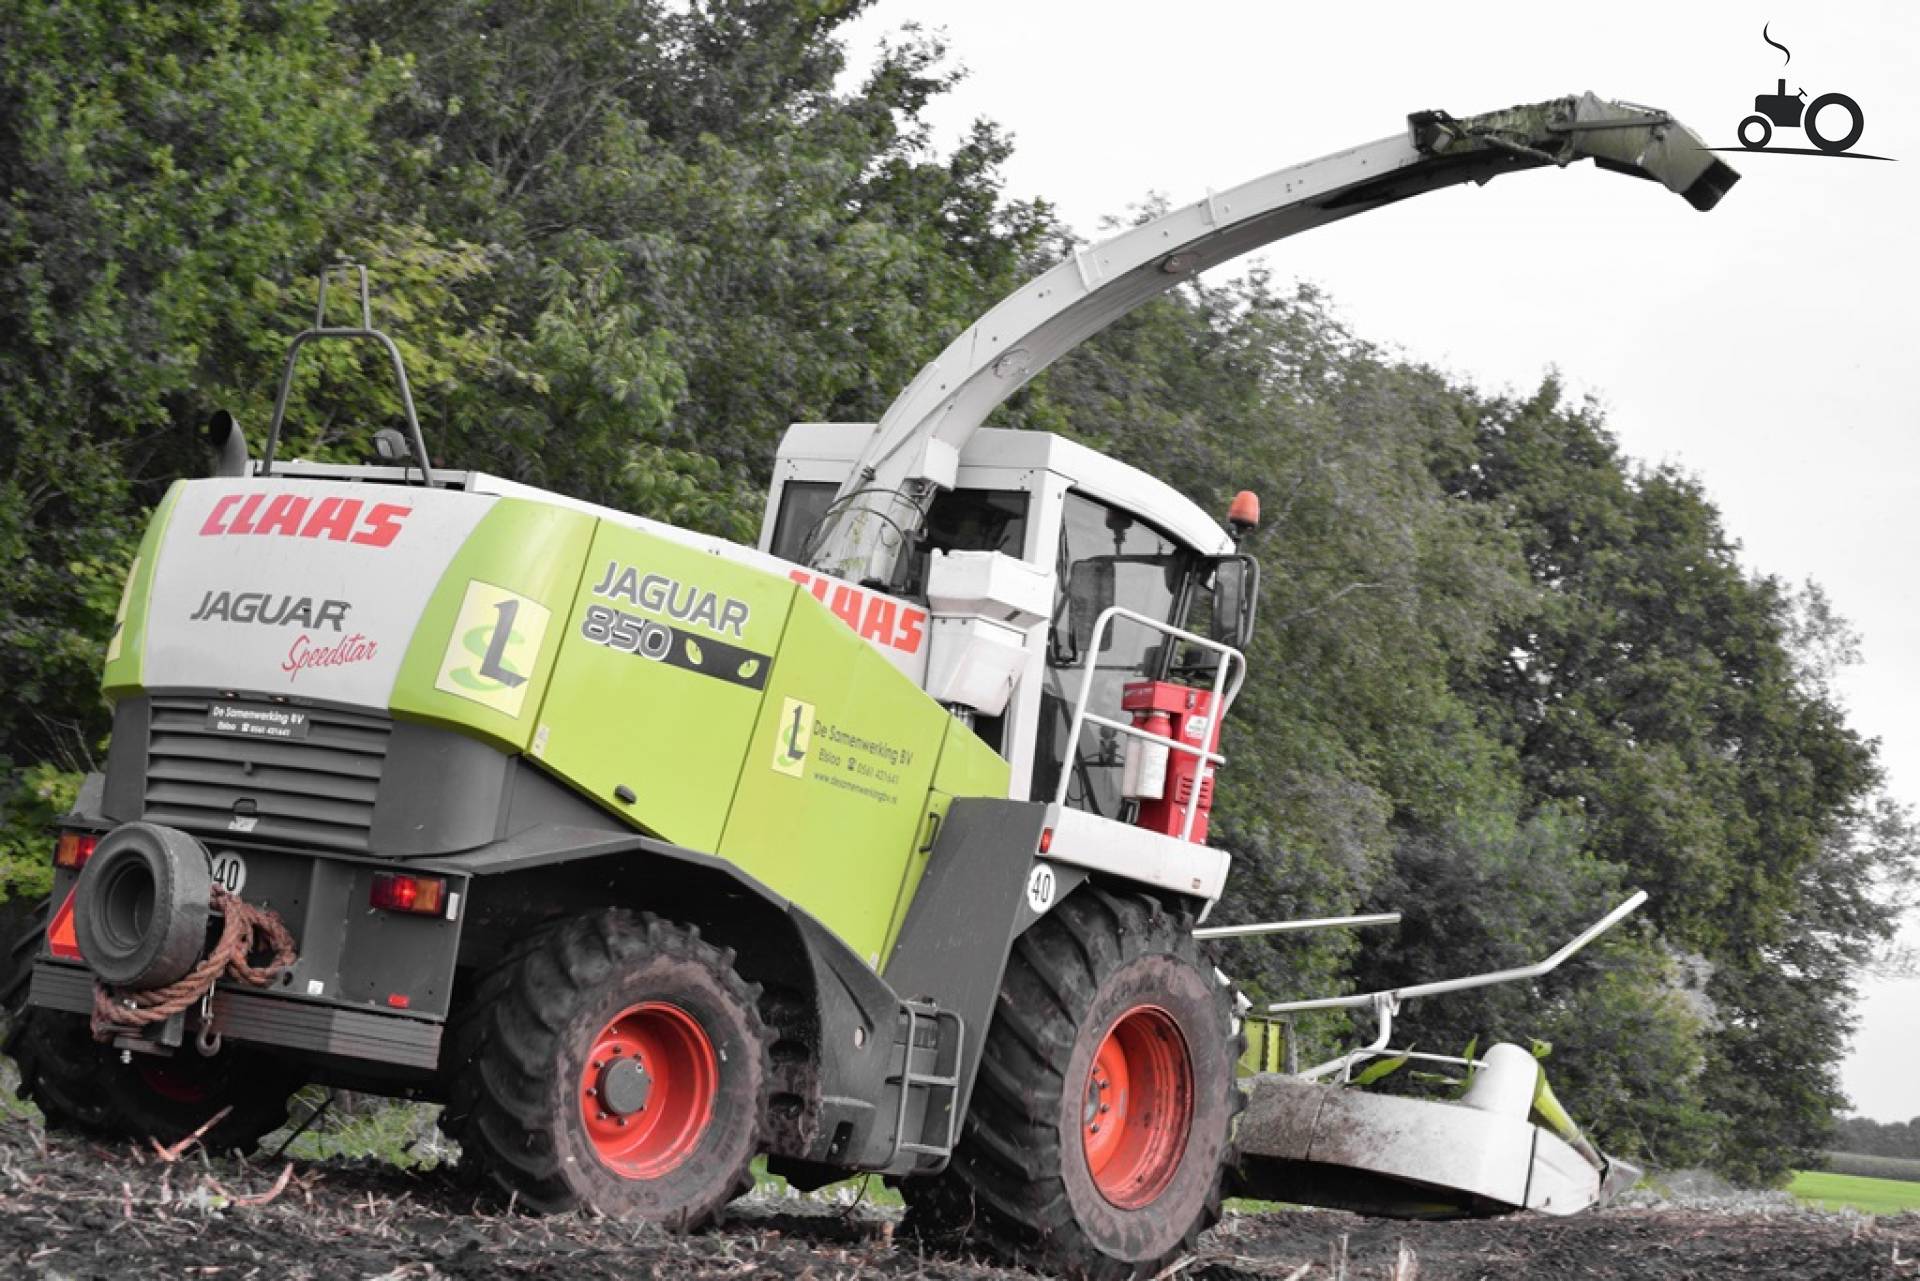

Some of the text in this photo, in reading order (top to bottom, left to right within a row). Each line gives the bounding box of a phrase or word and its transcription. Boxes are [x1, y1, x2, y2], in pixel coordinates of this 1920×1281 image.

[199, 494, 413, 548] CLAAS
[190, 590, 351, 631] JAGUAR
[592, 560, 749, 638] JAGUAR
[789, 569, 926, 653] AAS
[581, 604, 672, 661] 850
[281, 634, 378, 682] Speedstar
[813, 719, 913, 766] De Samenwerking BV
[213, 858, 239, 891] 40
[1031, 871, 1051, 903] 40
